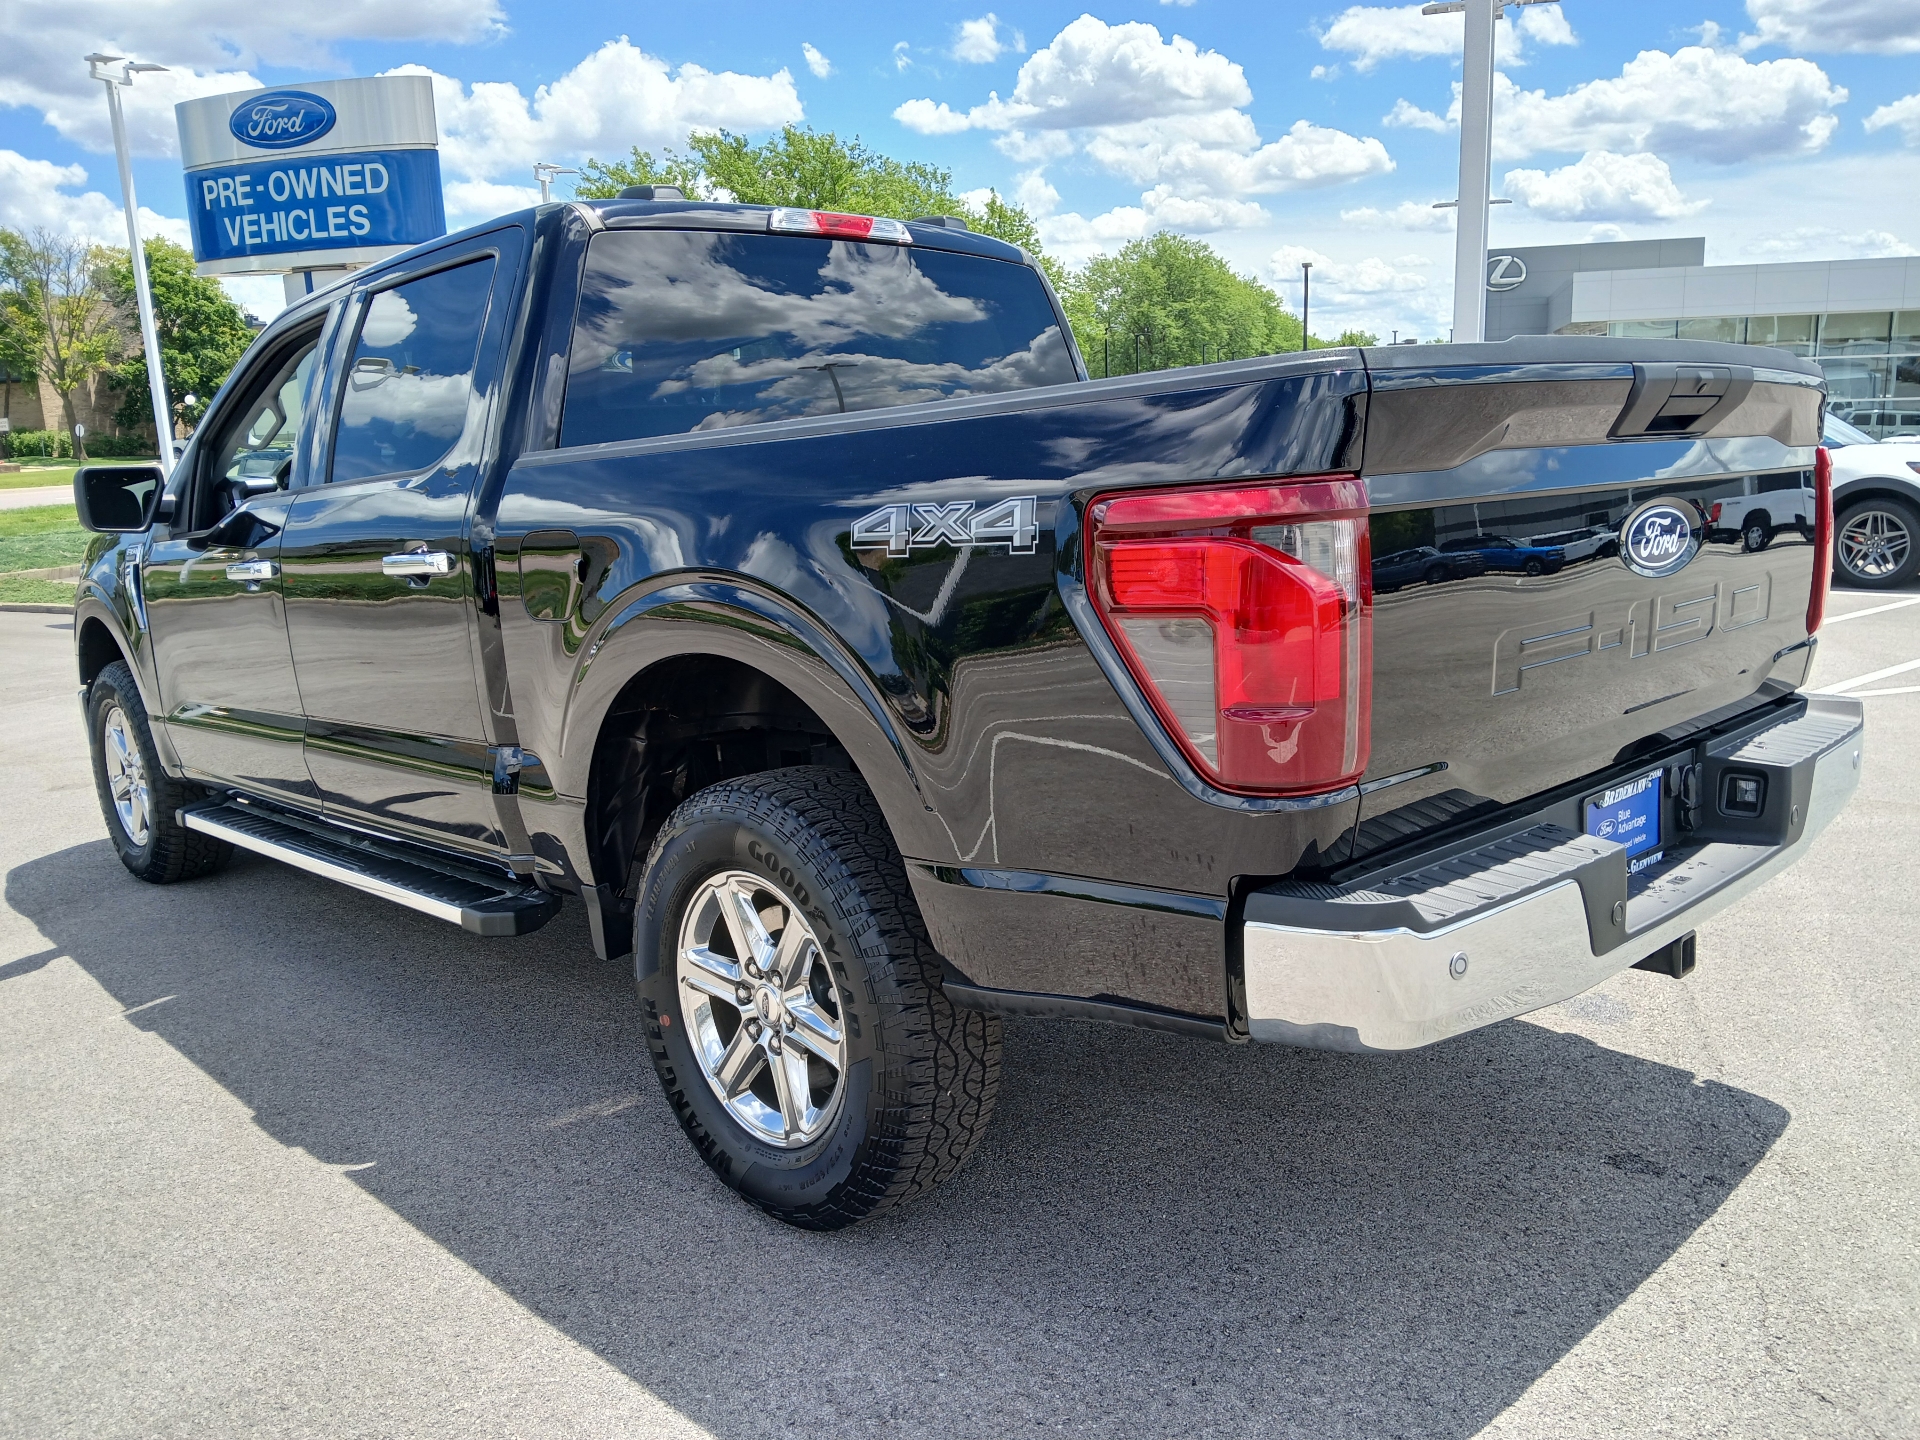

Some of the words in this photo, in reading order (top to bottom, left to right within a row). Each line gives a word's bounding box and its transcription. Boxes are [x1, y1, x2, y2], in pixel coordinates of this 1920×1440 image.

[247, 103, 306, 137] Ford
[224, 205, 371, 246] VEHICLES
[1641, 516, 1684, 558] Ford
[1491, 569, 1773, 697] F-150
[1603, 778, 1647, 808] BREDEMANN
[1617, 808, 1631, 823] Blue
[1617, 814, 1647, 836] Advantage
[1633, 832, 1647, 846] Vehicle
[643, 996, 735, 1176] WRANGLER
